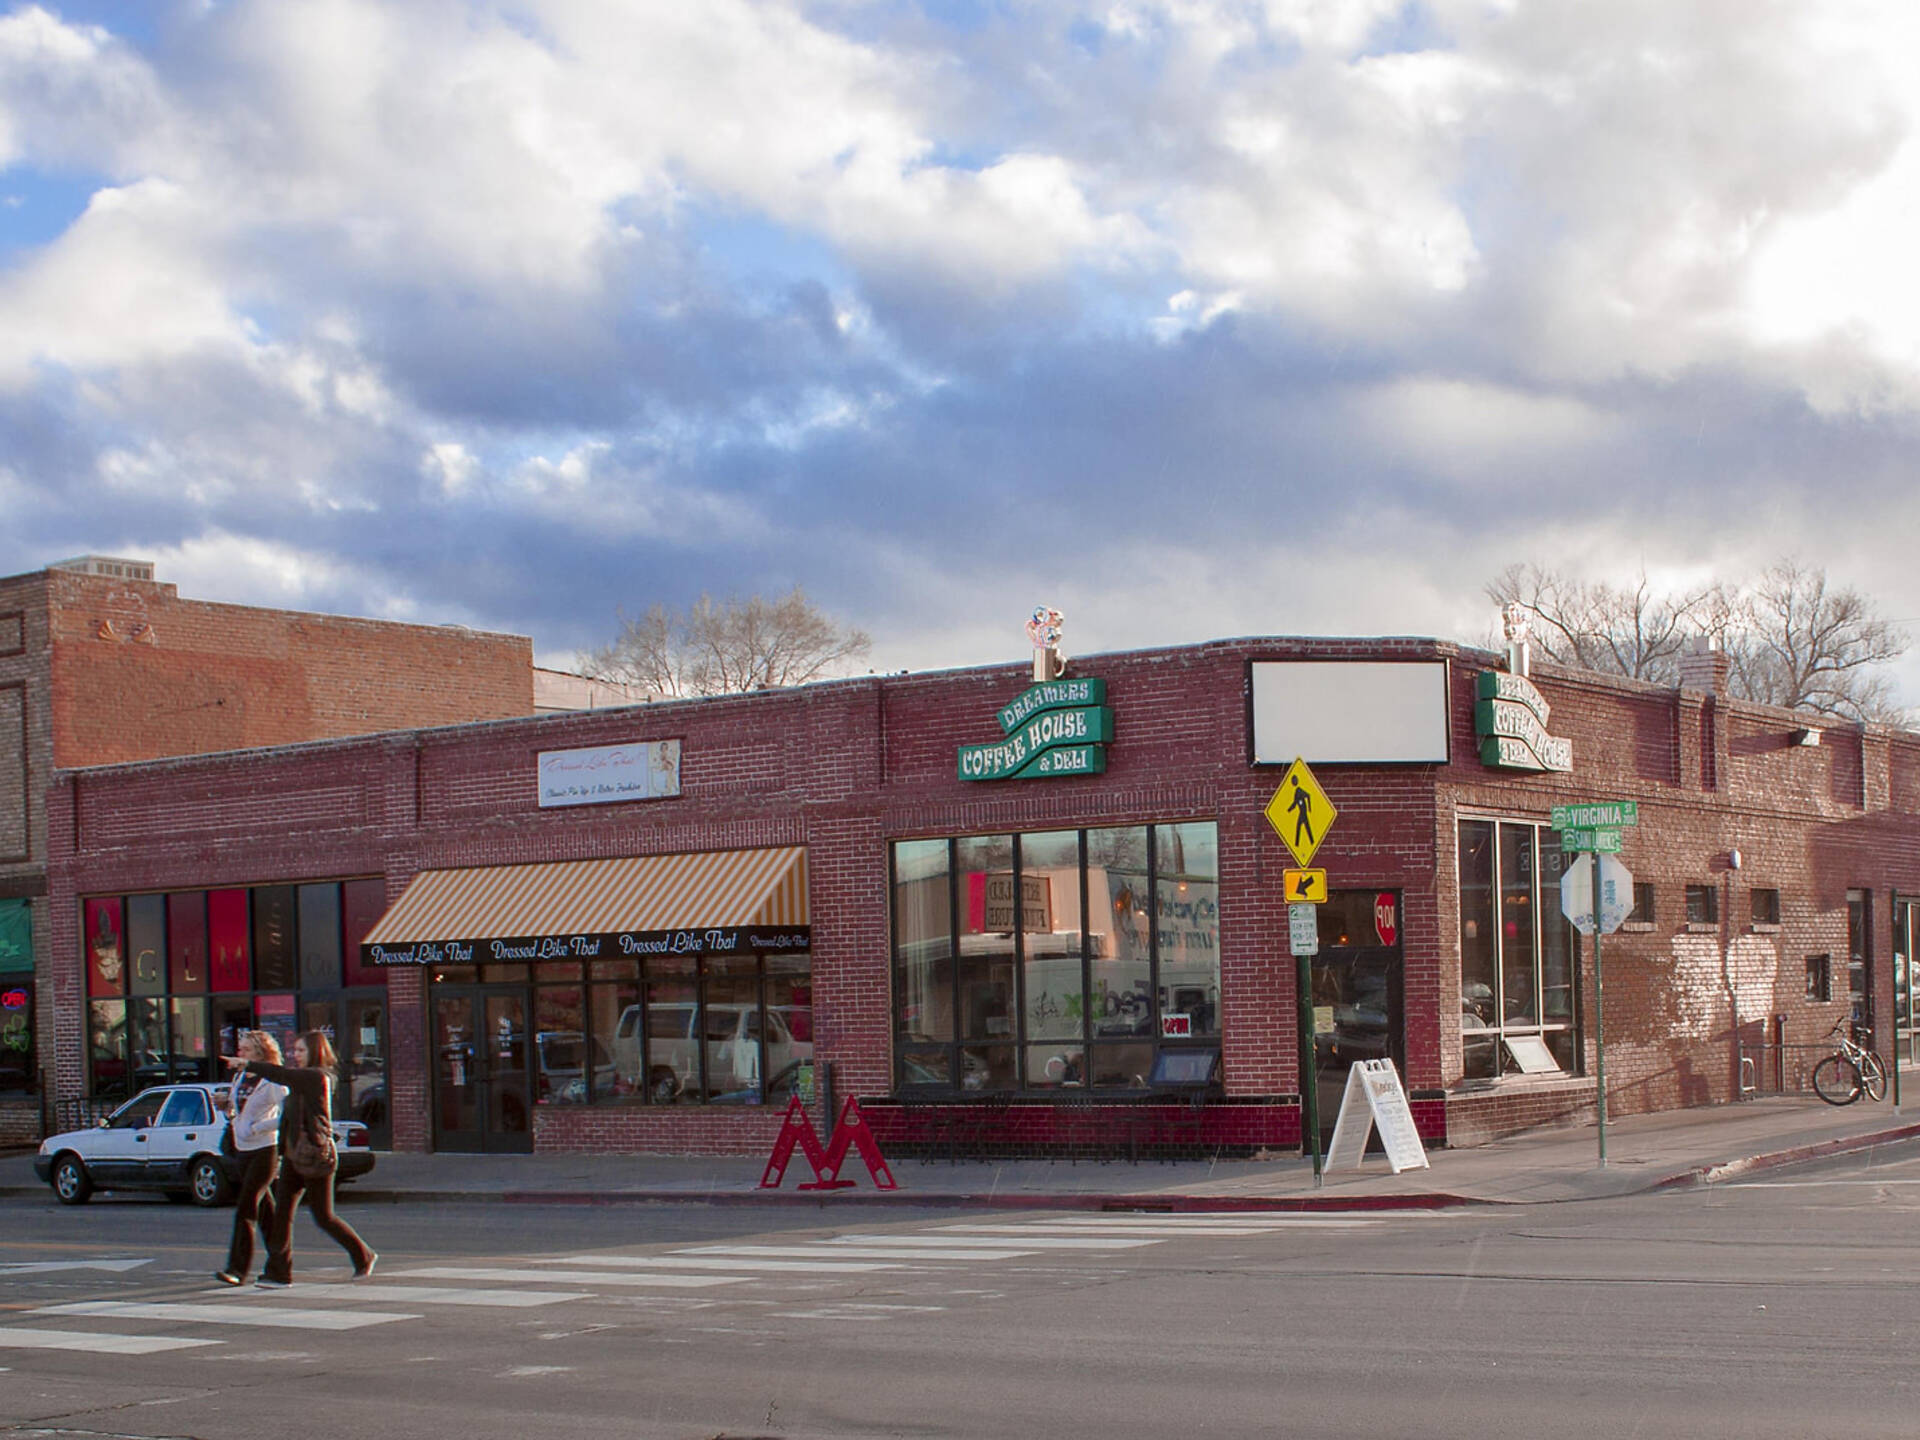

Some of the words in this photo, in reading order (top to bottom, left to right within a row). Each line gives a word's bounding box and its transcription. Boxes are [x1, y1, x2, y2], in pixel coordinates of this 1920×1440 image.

[1003, 682, 1089, 728] DREAMERS
[1494, 703, 1535, 739] COFFEE
[962, 735, 1027, 776] COFFEE
[1028, 711, 1088, 751] HOUSE
[1039, 757, 1051, 772] &
[1053, 750, 1087, 770] DELI
[1571, 806, 1622, 827] VIRGINIA
[490, 939, 538, 959] Dressed
[537, 937, 568, 959] Like
[570, 936, 600, 955] That
[619, 934, 670, 954] Dressed
[669, 931, 702, 954] Like
[705, 929, 737, 949] That
[750, 935, 777, 947] Dressed
[775, 934, 793, 948] Like
[792, 935, 809, 946] That
[370, 944, 417, 964] Dressed
[415, 943, 443, 963] Like
[445, 942, 473, 960] That
[1163, 1017, 1189, 1034] OPEN
